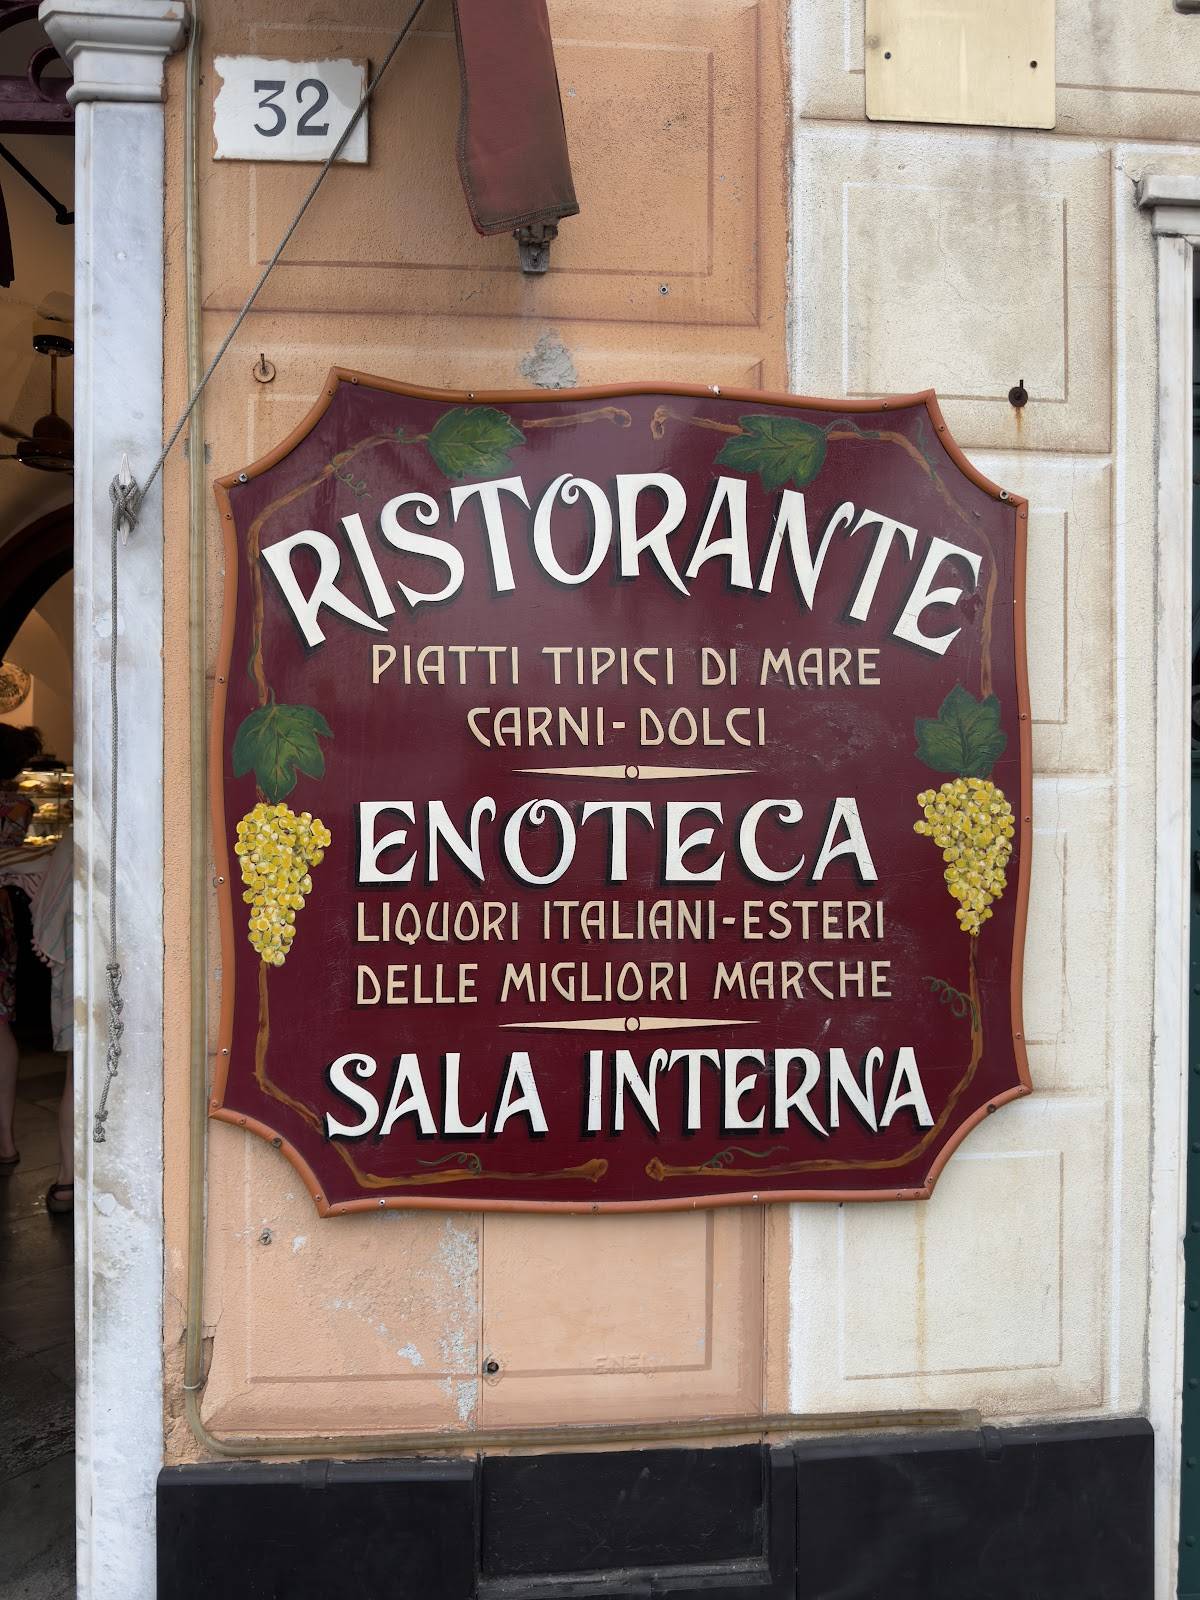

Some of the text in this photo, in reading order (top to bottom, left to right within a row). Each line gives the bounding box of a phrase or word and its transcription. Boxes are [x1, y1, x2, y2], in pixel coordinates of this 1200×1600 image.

[253, 79, 330, 137] 32
[261, 473, 982, 655] RISTORANTE
[373, 645, 881, 685] PIATTI TIPICI DI MARE
[359, 796, 878, 884] ENOTECA
[358, 901, 519, 946] LIQUORI
[358, 961, 892, 1004] DELLE MIGLIORI MARCHE
[327, 1047, 934, 1137] SALA INTERNA
